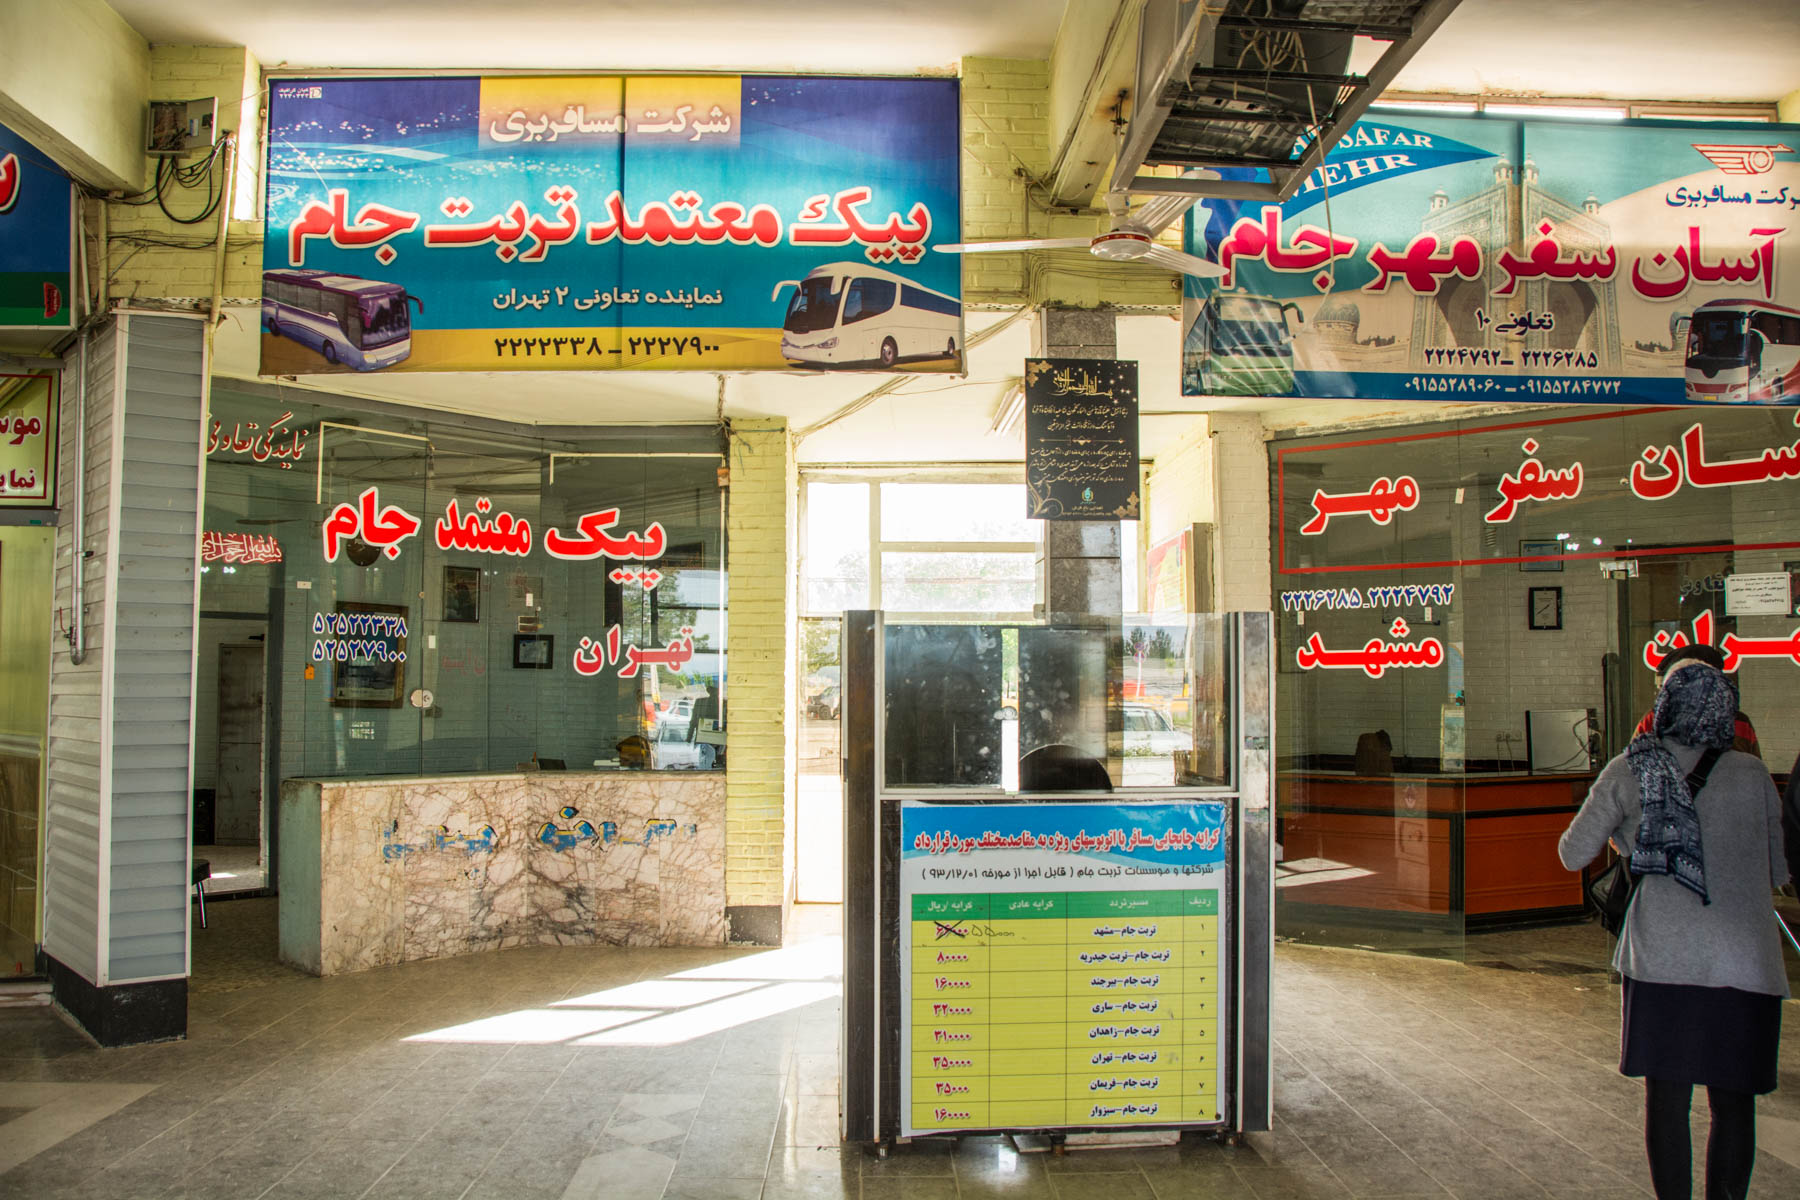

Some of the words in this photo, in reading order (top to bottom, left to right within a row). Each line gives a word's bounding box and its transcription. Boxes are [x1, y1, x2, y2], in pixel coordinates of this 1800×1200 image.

[489, 105, 628, 142] مسافربری
[637, 105, 731, 142] شرکت
[1665, 184, 1752, 208] مسافربری
[1756, 186, 1800, 210] رکت
[287, 188, 420, 267] جام
[421, 185, 580, 264] تربت
[584, 190, 784, 248] معتمد
[1218, 205, 1360, 293] جام
[1490, 217, 1618, 297] سفر
[1361, 231, 1484, 297] مهر
[1630, 225, 1787, 302] آسان
[493, 288, 550, 311] تهران
[555, 286, 569, 306] ۲
[573, 287, 640, 311] تعاونی
[645, 287, 723, 309] نماینده
[1494, 310, 1555, 337] تعاونی
[494, 336, 602, 357] ۲۲۲۲۳۳۸
[628, 336, 719, 356] ۲۲۲۷۹۰۰
[1424, 348, 1501, 367] ۲۲۲۴۷۹۲
[1521, 350, 1599, 369] ۲۲۲۶۲۸۵
[1630, 408, 1800, 501] سان
[1484, 438, 1583, 523] سفر
[1301, 474, 1420, 535] مهر
[322, 486, 421, 563] جام
[435, 496, 532, 556] معتمد
[544, 507, 667, 589] پیک
[313, 612, 408, 638] ۵۲۵۲۲۳۳۸
[313, 639, 407, 662] ۵۲۵۲۷۹۰۰
[572, 623, 695, 678] تهران
[1296, 617, 1444, 679] مشهد
[914, 830, 950, 853] قرارداد
[952, 832, 975, 853] مورد
[1037, 832, 1048, 850] به
[1048, 831, 1070, 853] ویژه
[1127, 827, 1154, 852] مسافر
[1195, 826, 1221, 850] کرایه
[1014, 867, 1021, 879] از
[1025, 867, 1041, 879] اجرا
[1044, 866, 1066, 879] قابل
[1077, 866, 1094, 877] جام
[1098, 866, 1121, 877] تربت
[1124, 865, 1170, 876] موسسات
[1182, 863, 1214, 876] شرکتها
[951, 901, 973, 912] کرایه
[1032, 899, 1054, 910] کرایه
[1138, 925, 1156, 937] تربت
[937, 951, 968, 962] ۸۰۰۰۰
[1080, 952, 1107, 963] حیدریه
[1151, 950, 1170, 962] تربت
[1140, 975, 1159, 987] تربت
[1139, 1000, 1158, 1012] تربت
[1141, 1025, 1160, 1037] تربت
[1138, 1051, 1157, 1063] تربت
[1140, 1077, 1158, 1089] تربت
[1139, 1104, 1158, 1116] تربت
